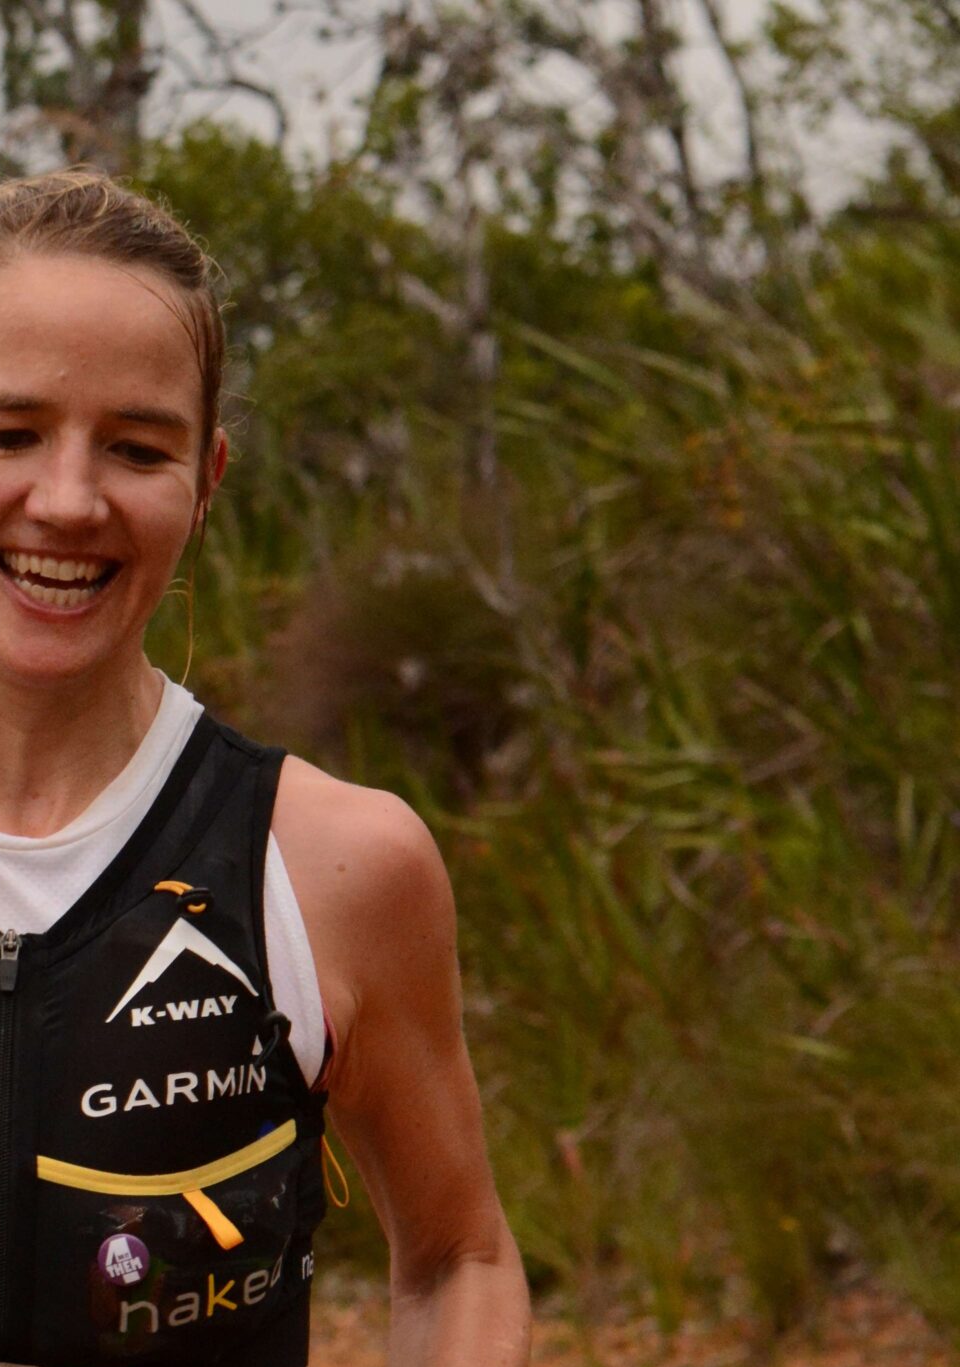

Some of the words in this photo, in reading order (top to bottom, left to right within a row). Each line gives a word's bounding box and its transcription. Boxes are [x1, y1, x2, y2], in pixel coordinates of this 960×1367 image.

[131, 995, 238, 1027] K-WAY
[81, 1063, 267, 1118] GARMIN
[106, 1256, 143, 1278] THEM
